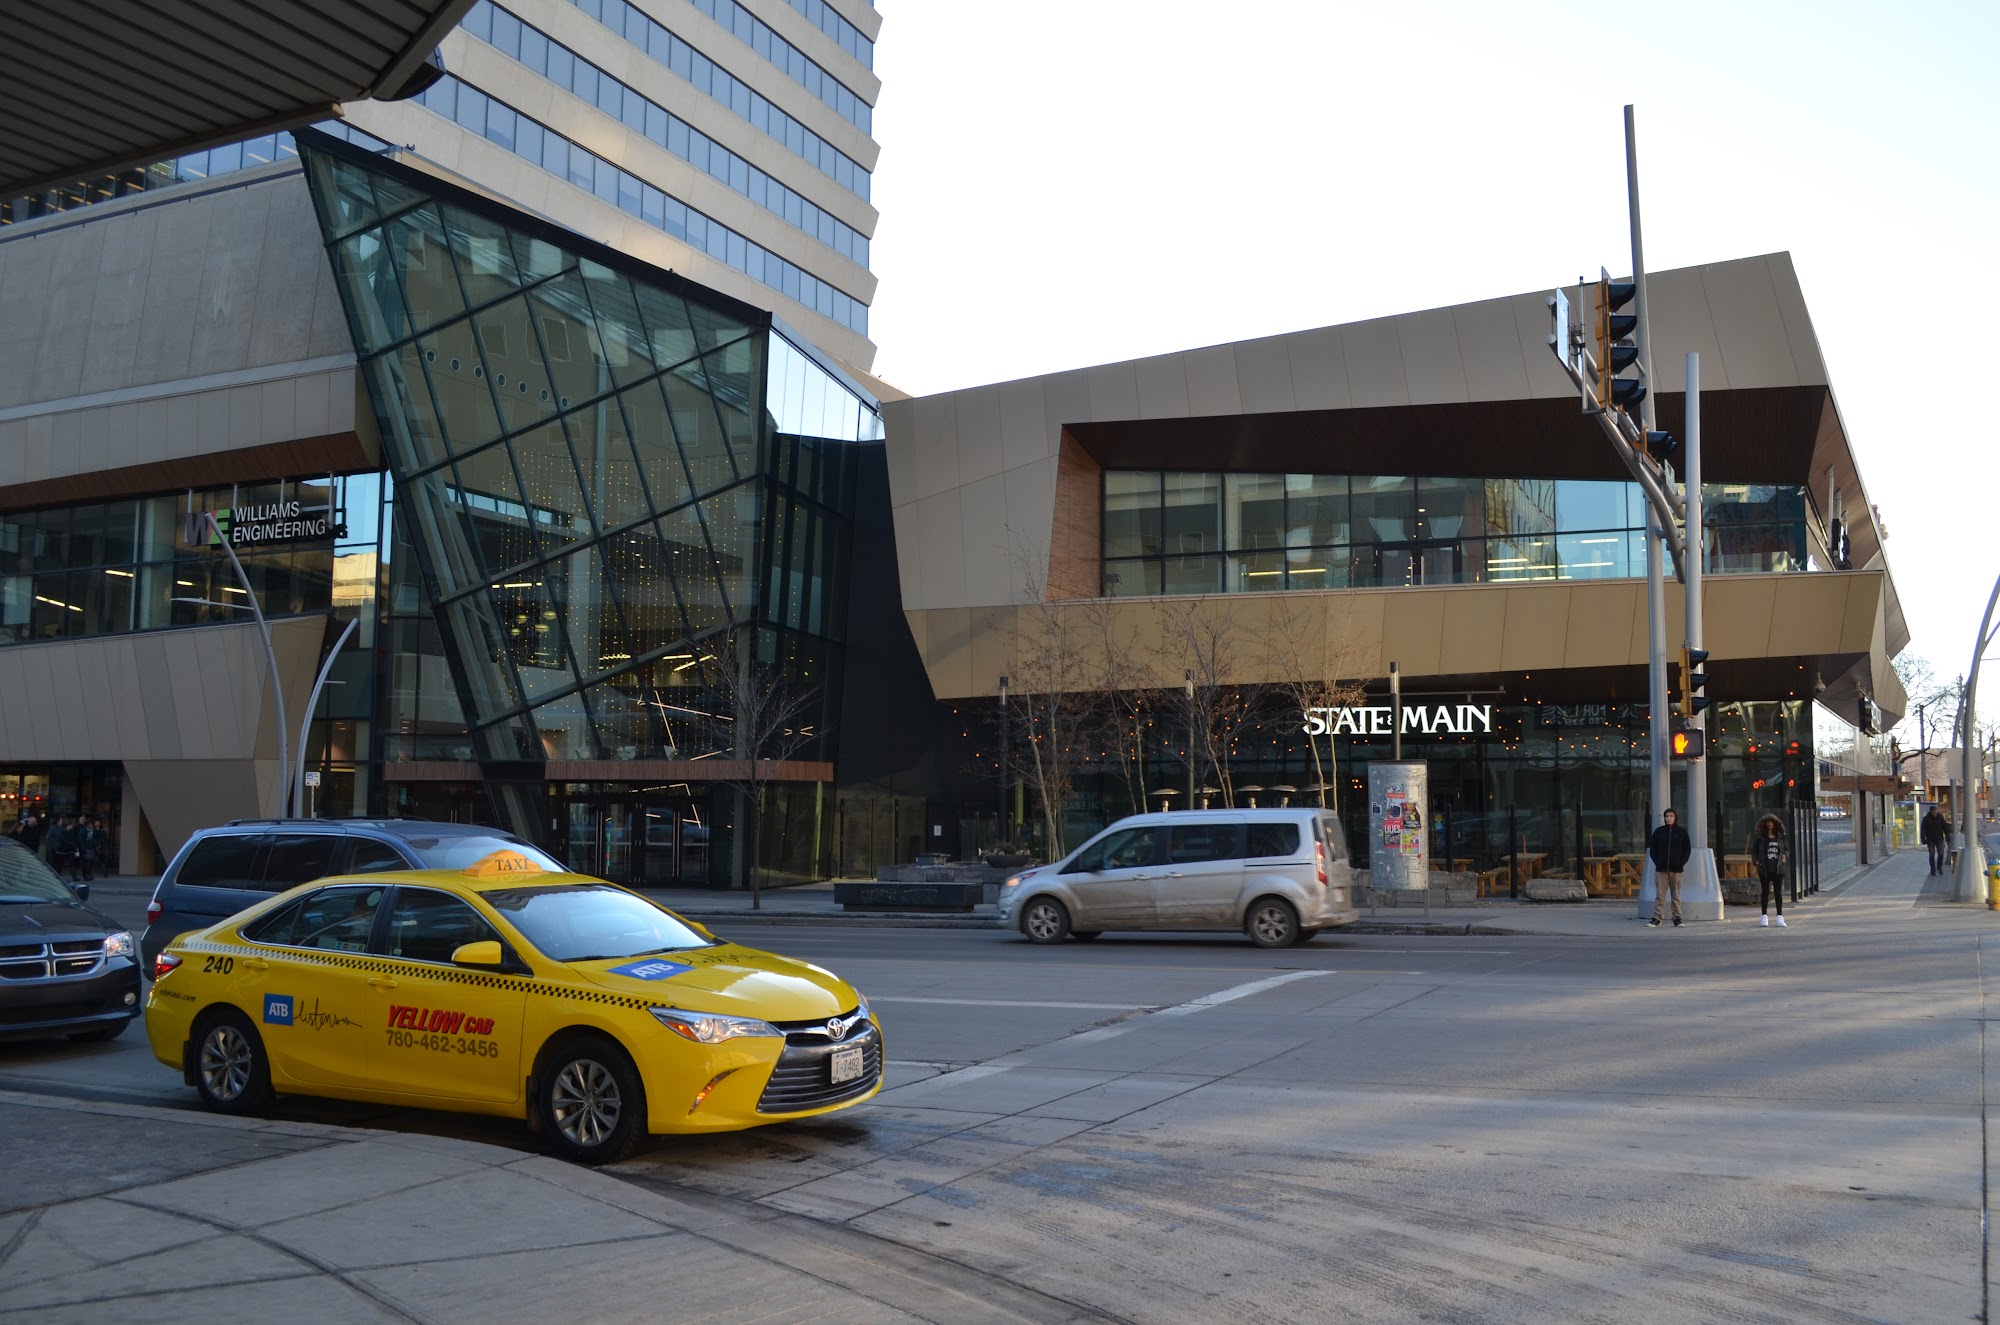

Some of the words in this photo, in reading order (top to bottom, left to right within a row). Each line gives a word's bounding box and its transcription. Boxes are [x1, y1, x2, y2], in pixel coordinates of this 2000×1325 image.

[234, 501, 300, 523] WILLIAMS
[233, 519, 326, 543] ENGINEERING
[1302, 706, 1393, 735] STATE
[1400, 705, 1492, 733] MAIN
[495, 858, 529, 871] TAXI
[203, 955, 234, 975] 240
[630, 962, 675, 978] ATB
[268, 1002, 289, 1017] ATB
[387, 1004, 466, 1035] YELLOW
[464, 1016, 495, 1035] CAB
[385, 1029, 499, 1058] 780-462-3456
